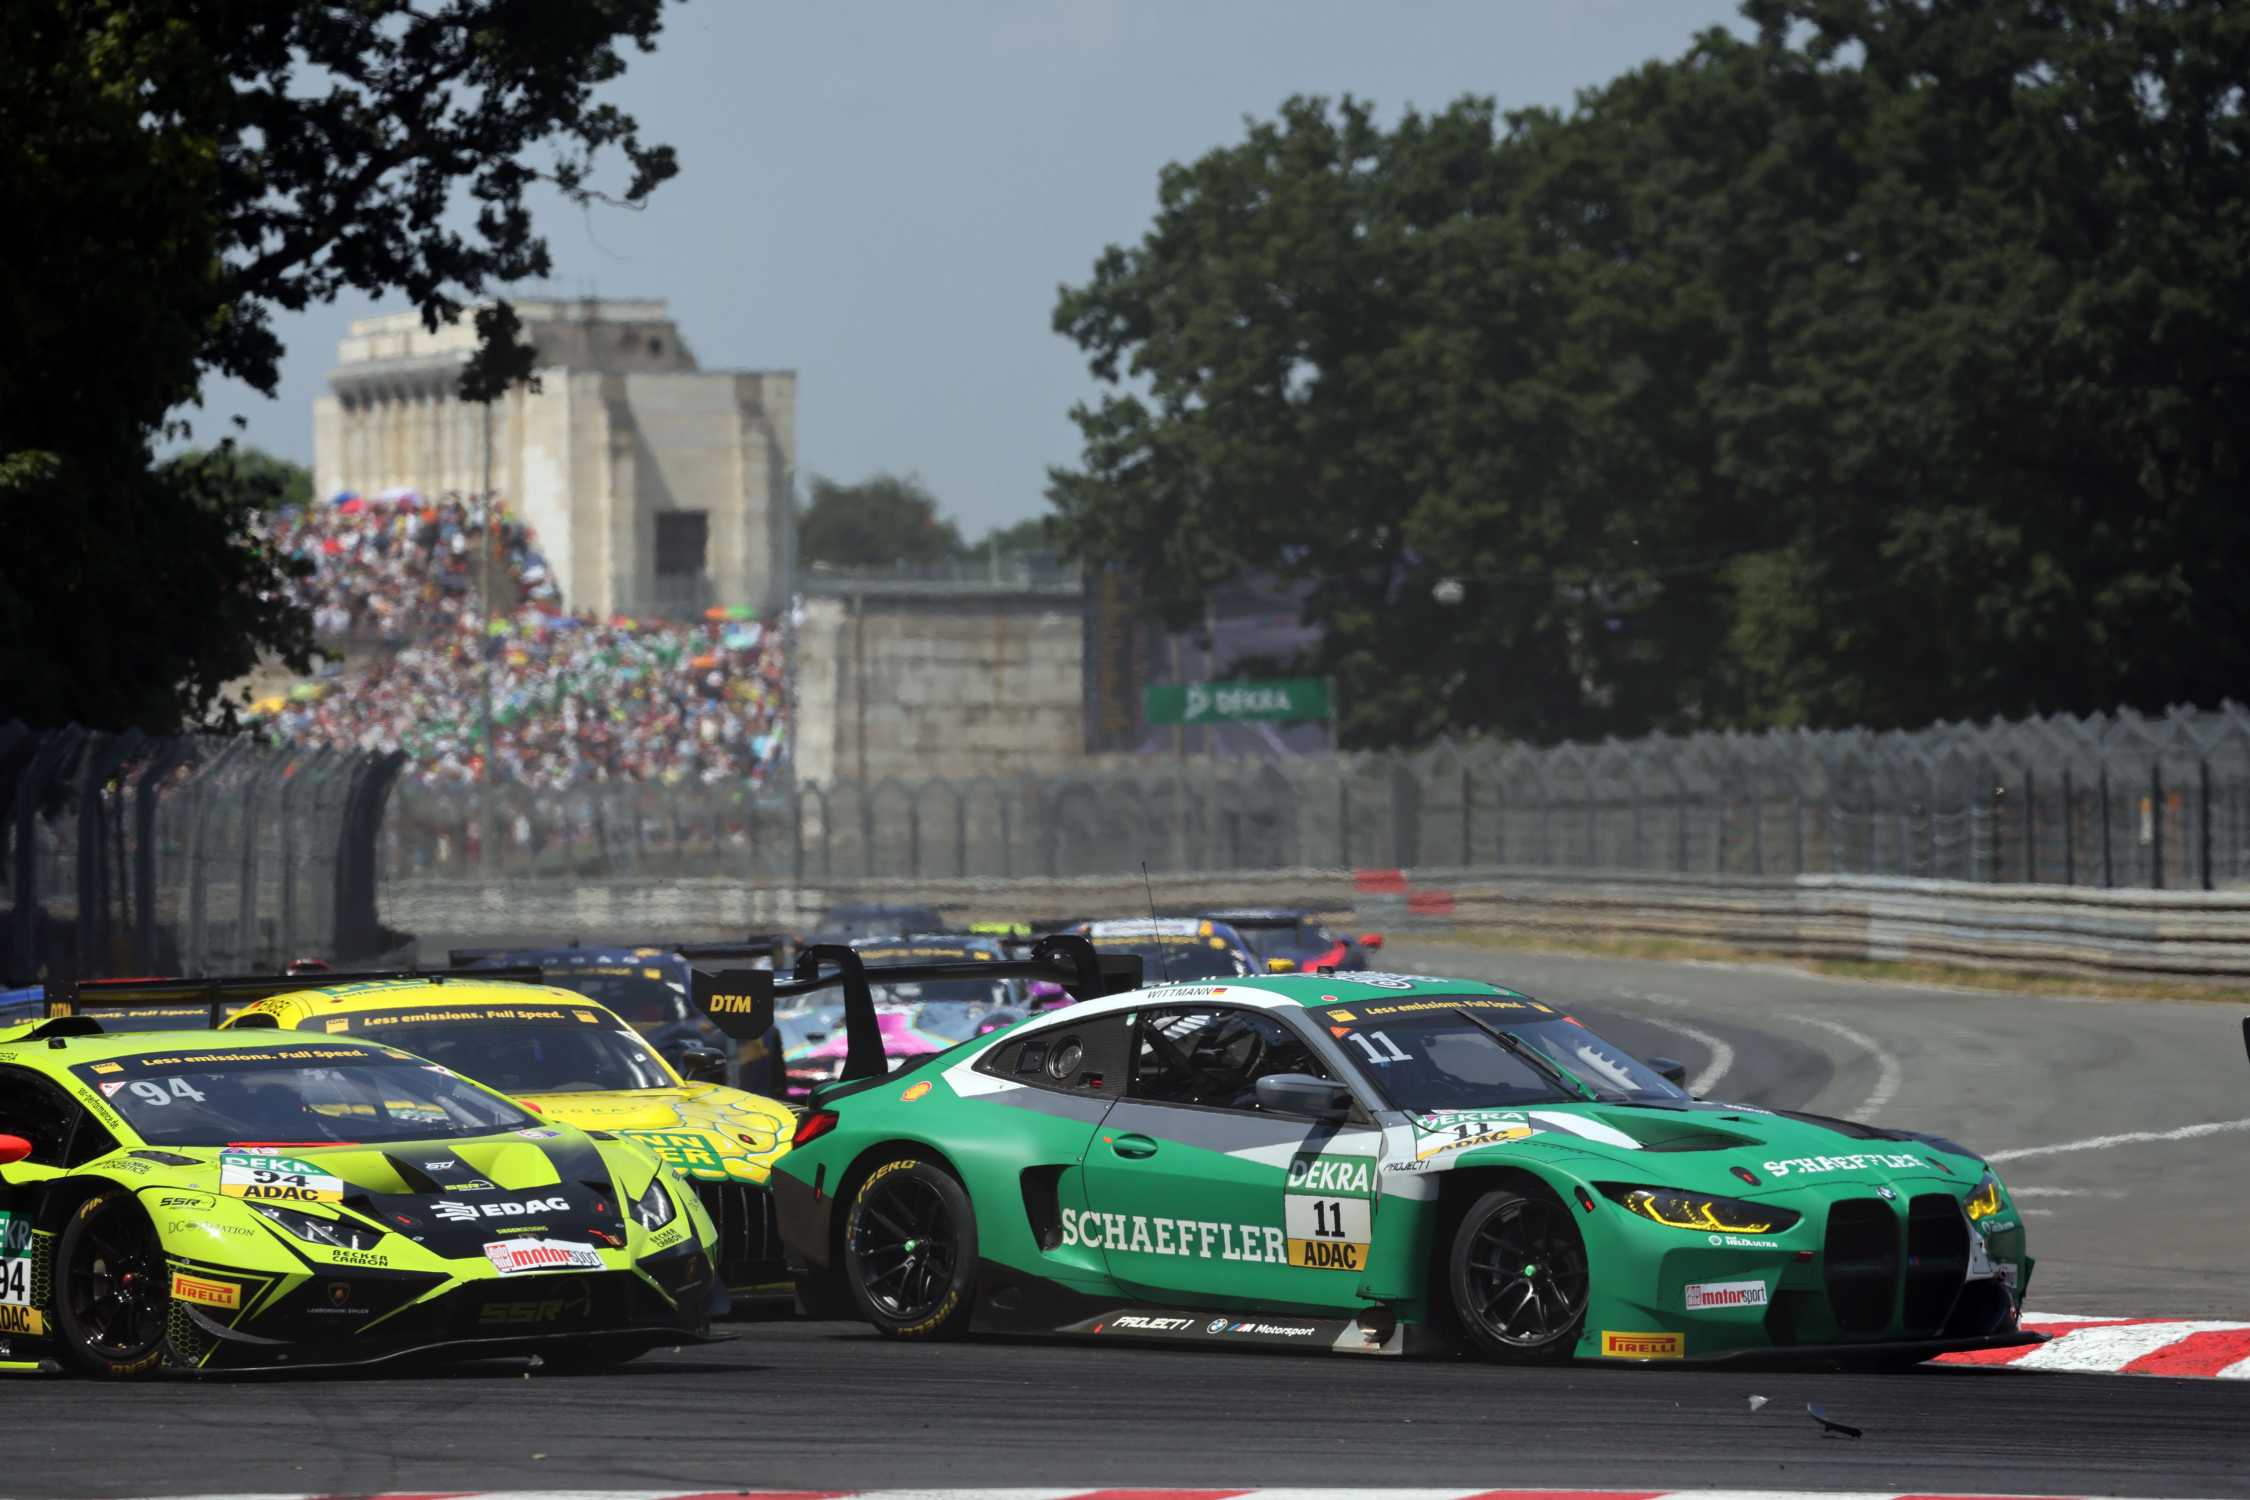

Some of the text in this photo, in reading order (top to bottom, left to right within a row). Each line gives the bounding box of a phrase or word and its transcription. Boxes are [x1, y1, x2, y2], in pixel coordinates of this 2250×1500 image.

[1147, 987, 1213, 999] WITTMANN
[710, 994, 752, 1013] DTM
[1365, 1006, 1397, 1015] Less
[364, 1009, 565, 1026] Less emissions. Full Speed.
[1348, 1031, 1414, 1064] 11
[142, 1049, 369, 1066] Less emissions. Full Speed.
[129, 1077, 206, 1106] 94
[1453, 1121, 1493, 1141] 11
[633, 1134, 705, 1149] NN
[1438, 1130, 1510, 1153] ADAC
[225, 1156, 321, 1173] DEKR
[253, 1170, 311, 1187] 94
[1287, 1160, 1369, 1192] DEKRA
[160, 1197, 201, 1207] SSR
[243, 1185, 319, 1201] ADAC
[481, 1197, 570, 1217] EDAG
[1313, 1200, 1346, 1238] 11
[1062, 1208, 1288, 1264] SCHAEFFLER
[332, 1250, 388, 1261] BECKER
[332, 1257, 388, 1267] CARBON
[1304, 1241, 1357, 1269] ADAC
[175, 1278, 233, 1304] PIRELLI
[1702, 1286, 1767, 1305] motorsport
[0, 1306, 30, 1332] DAC
[1112, 1316, 1184, 1331] PROJECT
[1254, 1324, 1315, 1337] Motorsport
[1609, 1336, 1676, 1353] PIRELLI
